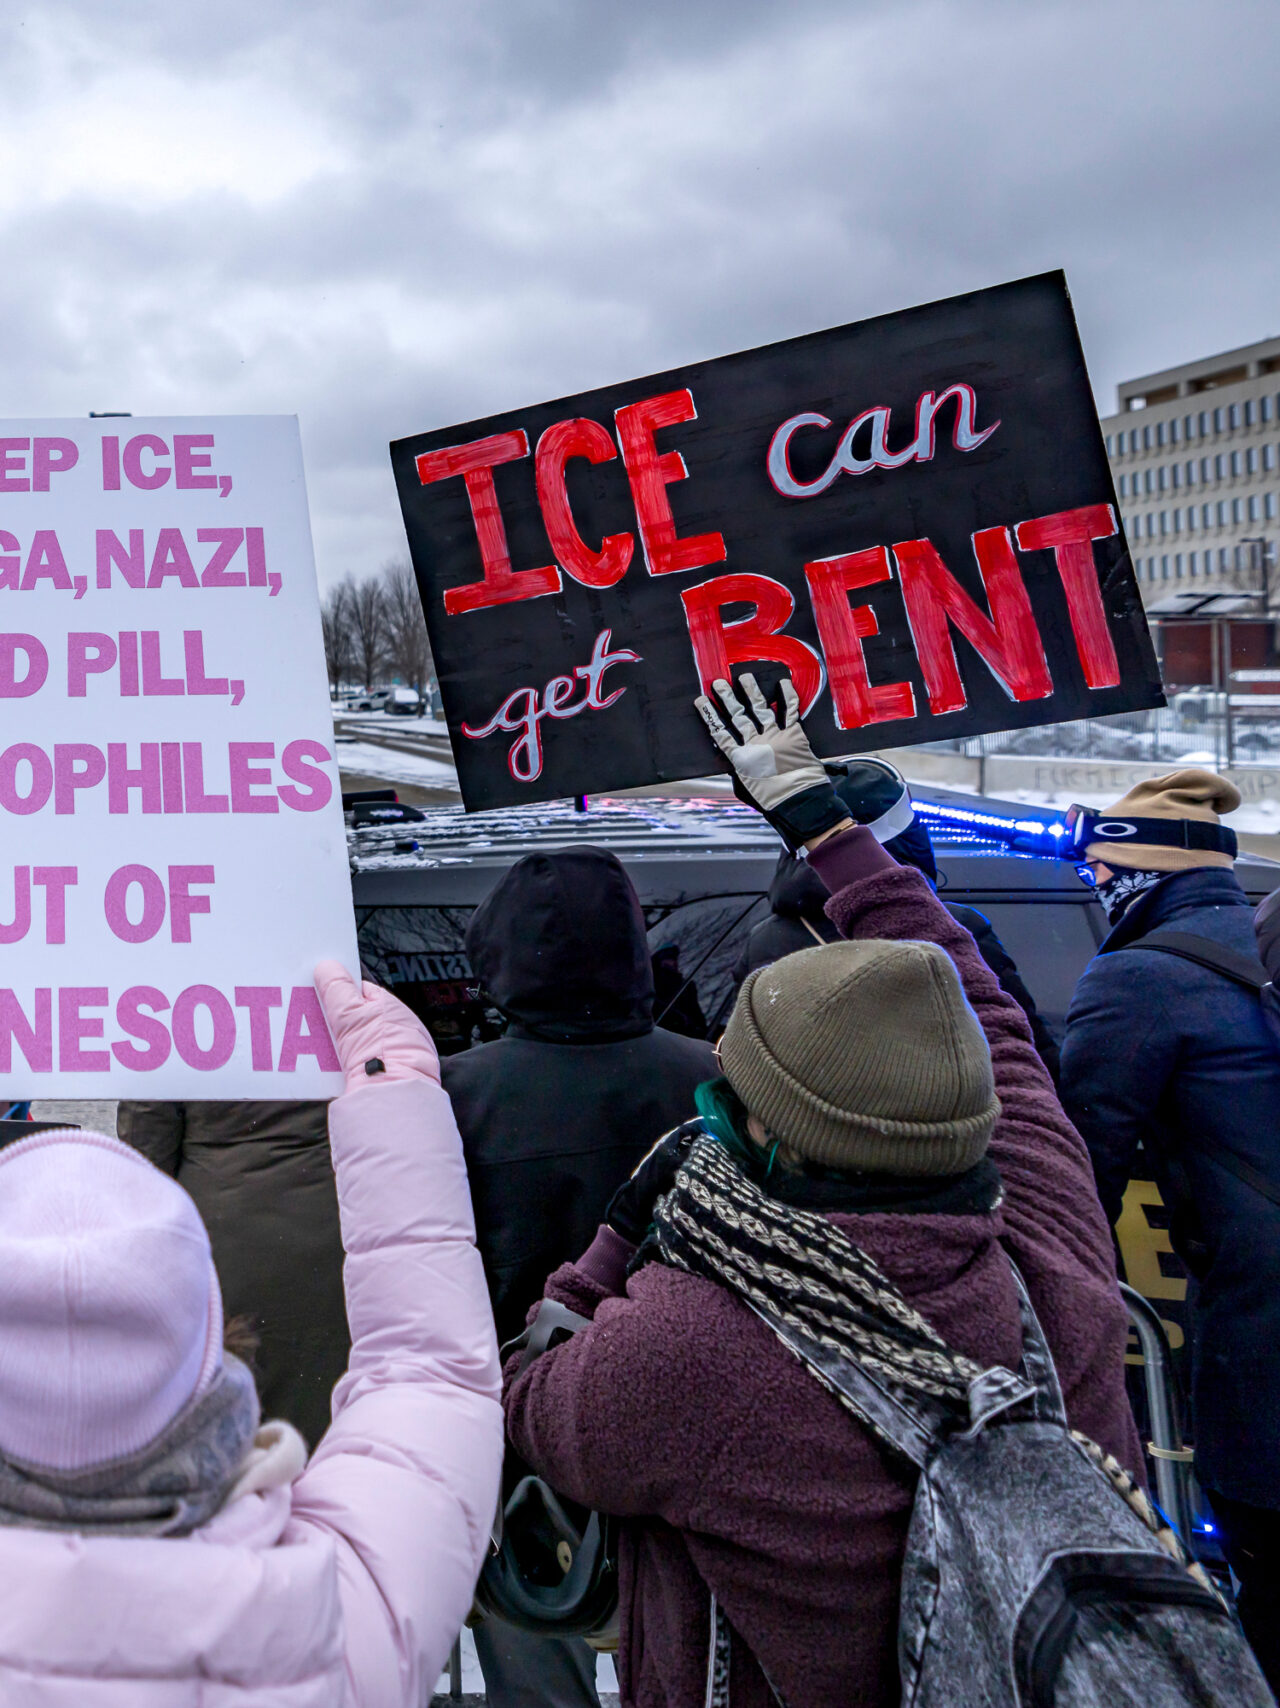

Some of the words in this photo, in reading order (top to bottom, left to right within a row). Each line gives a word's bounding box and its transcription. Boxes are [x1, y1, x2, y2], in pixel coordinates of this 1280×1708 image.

[101, 434, 232, 498] ICE,
[415, 388, 727, 616] ICE
[767, 383, 1001, 499] can
[95, 527, 283, 597] NAZI,
[67, 630, 245, 706] PILL,
[461, 628, 644, 783] get
[680, 503, 1119, 731] BENT
[103, 863, 215, 944] OF
